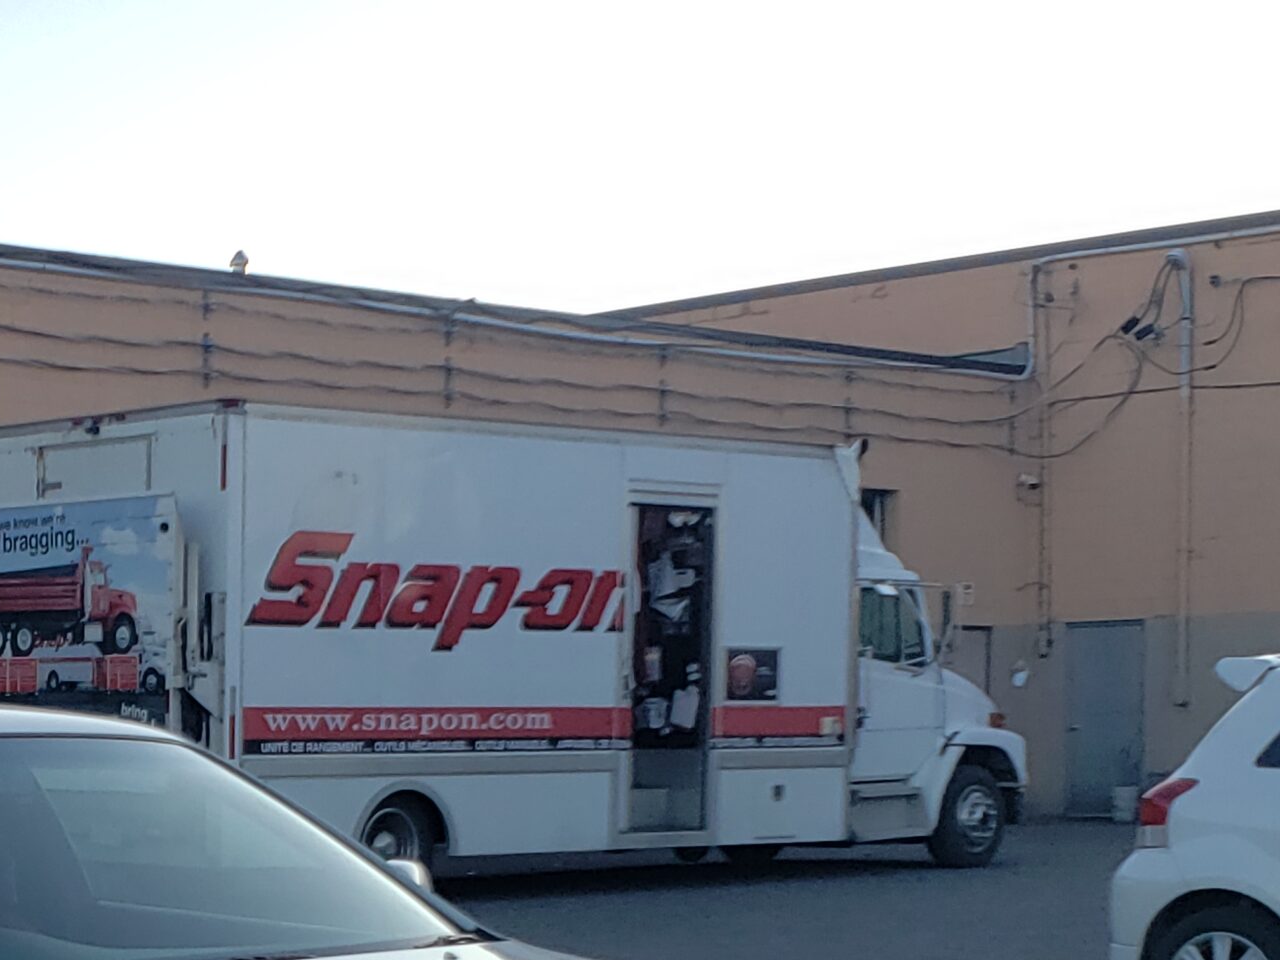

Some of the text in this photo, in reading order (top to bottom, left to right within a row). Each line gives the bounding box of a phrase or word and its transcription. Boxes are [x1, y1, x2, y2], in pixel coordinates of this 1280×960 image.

[245, 530, 625, 652] Snap-on
[120, 702, 148, 723] bring
[263, 710, 553, 735] www.snapon.com
